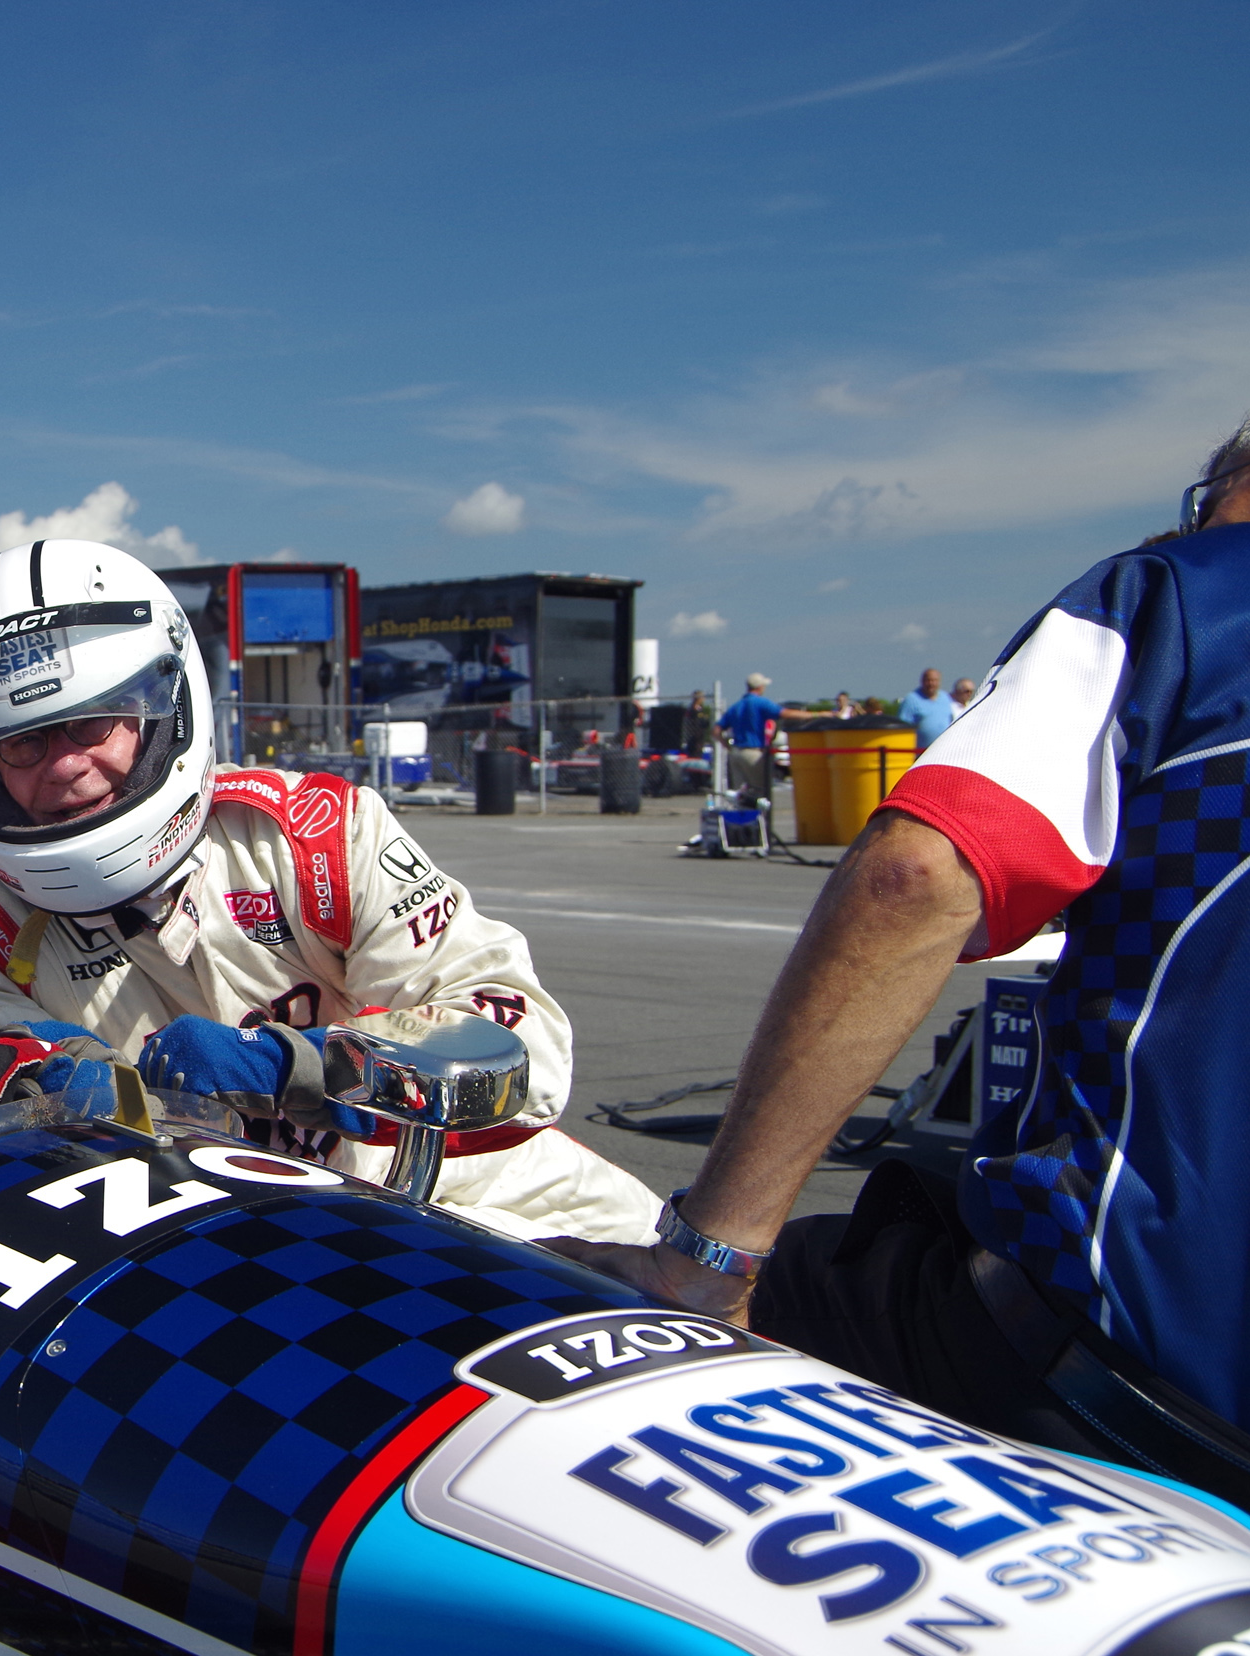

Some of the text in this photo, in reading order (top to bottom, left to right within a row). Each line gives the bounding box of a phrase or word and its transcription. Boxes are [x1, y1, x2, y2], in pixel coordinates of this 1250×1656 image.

[380, 615, 514, 638] ShopHonda.com
[0, 661, 62, 686] IN SPORTS
[13, 682, 58, 701] HONDA
[161, 801, 200, 849] INDYCAR
[527, 1318, 735, 1383] IZOD
[565, 1381, 999, 1548] FASTES
[986, 1521, 1230, 1604] SPORT
